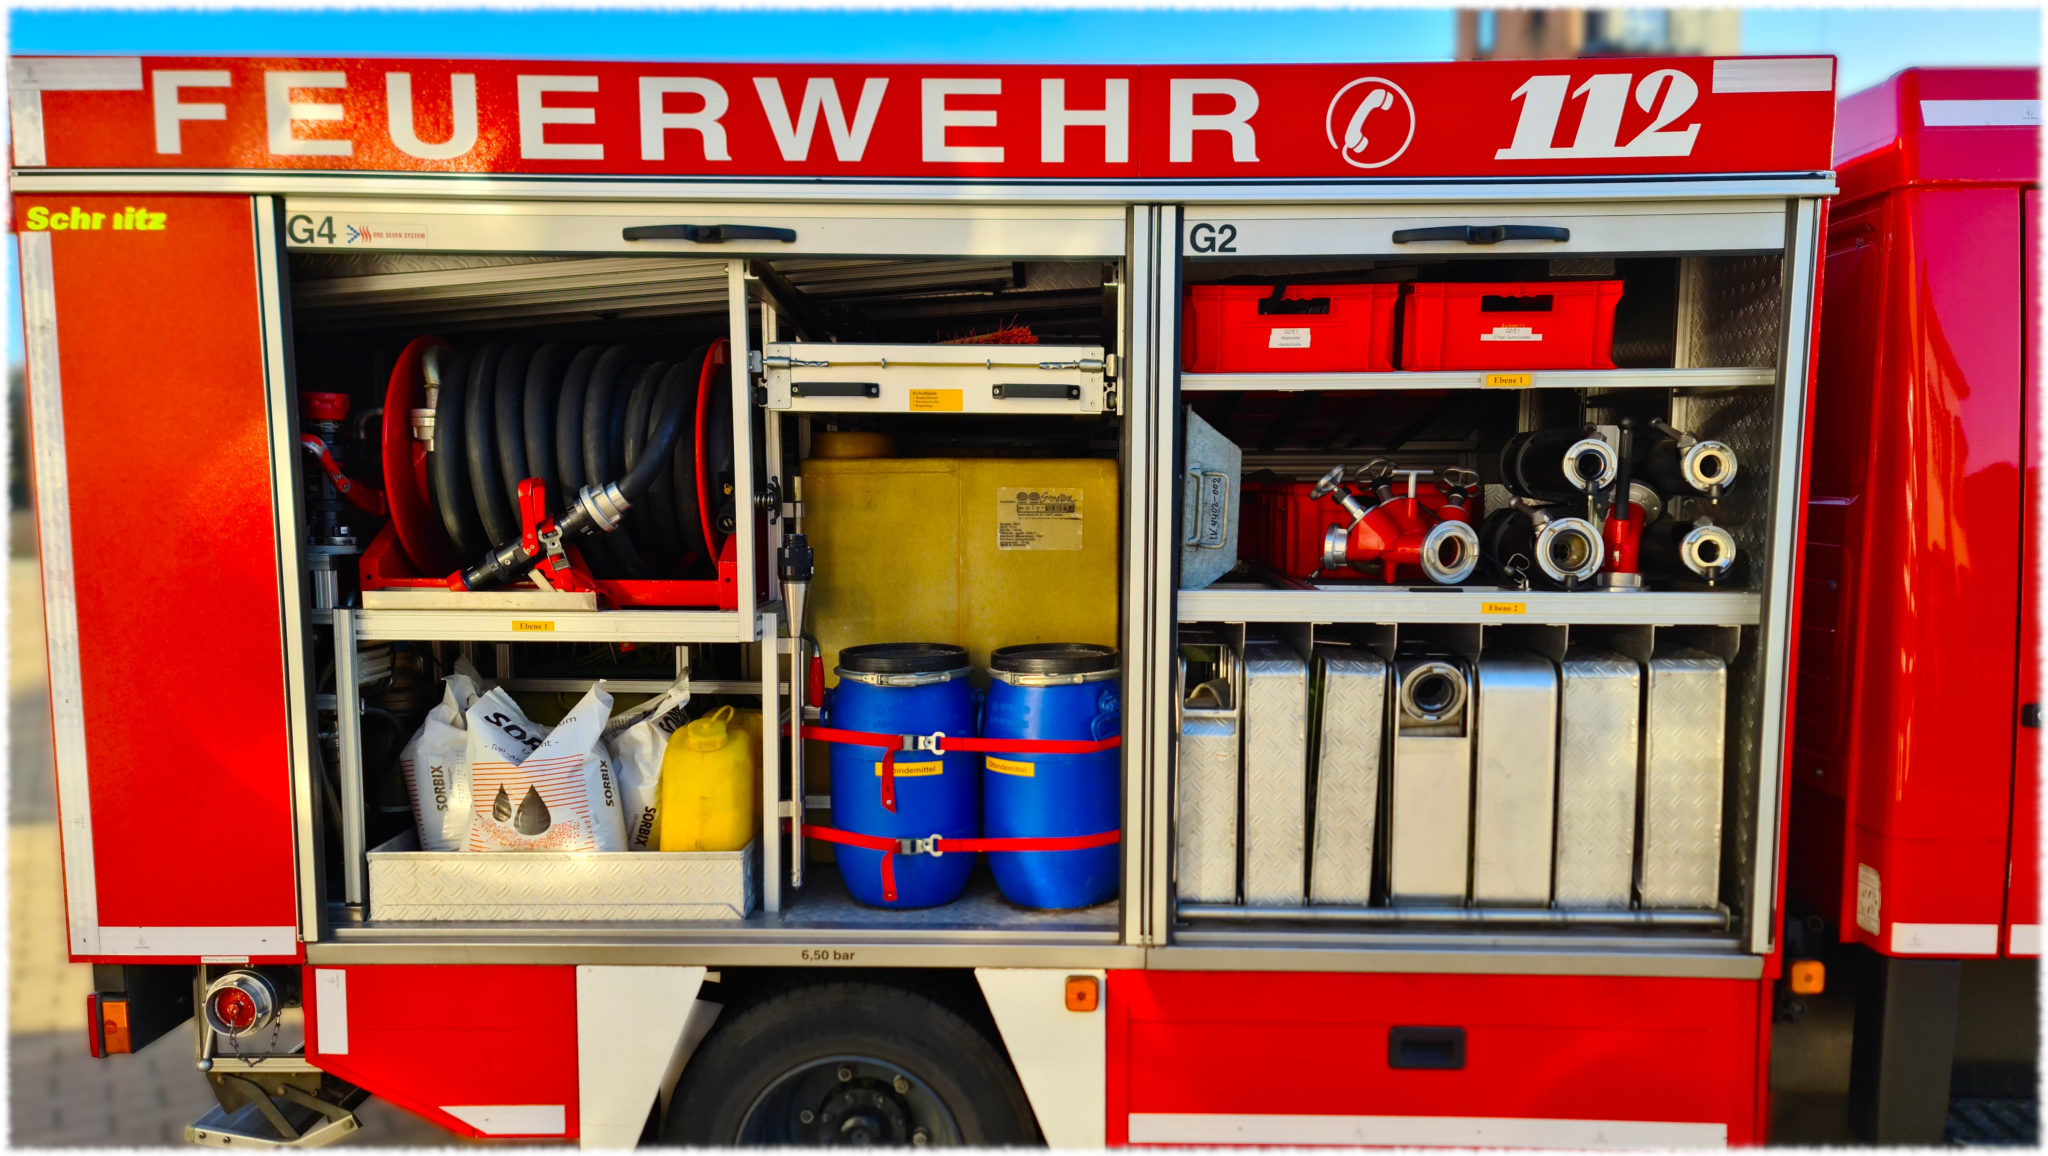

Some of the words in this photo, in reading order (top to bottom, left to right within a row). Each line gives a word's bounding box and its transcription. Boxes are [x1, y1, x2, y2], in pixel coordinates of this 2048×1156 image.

[151, 69, 1261, 163] FEUERWEHR
[1494, 68, 1702, 160] 112
[288, 214, 336, 244] G4
[1190, 223, 1237, 253] G2
[1494, 376, 1517, 384] Ebene
[1519, 376, 1523, 384] 1
[1488, 604, 1511, 612] Ebene
[520, 622, 542, 630] Ebene
[430, 764, 448, 812] SORBIX
[600, 759, 614, 807] SORBIX
[634, 805, 656, 847] SORBIX
[801, 949, 829, 962] 6,50
[833, 949, 856, 960] bar
